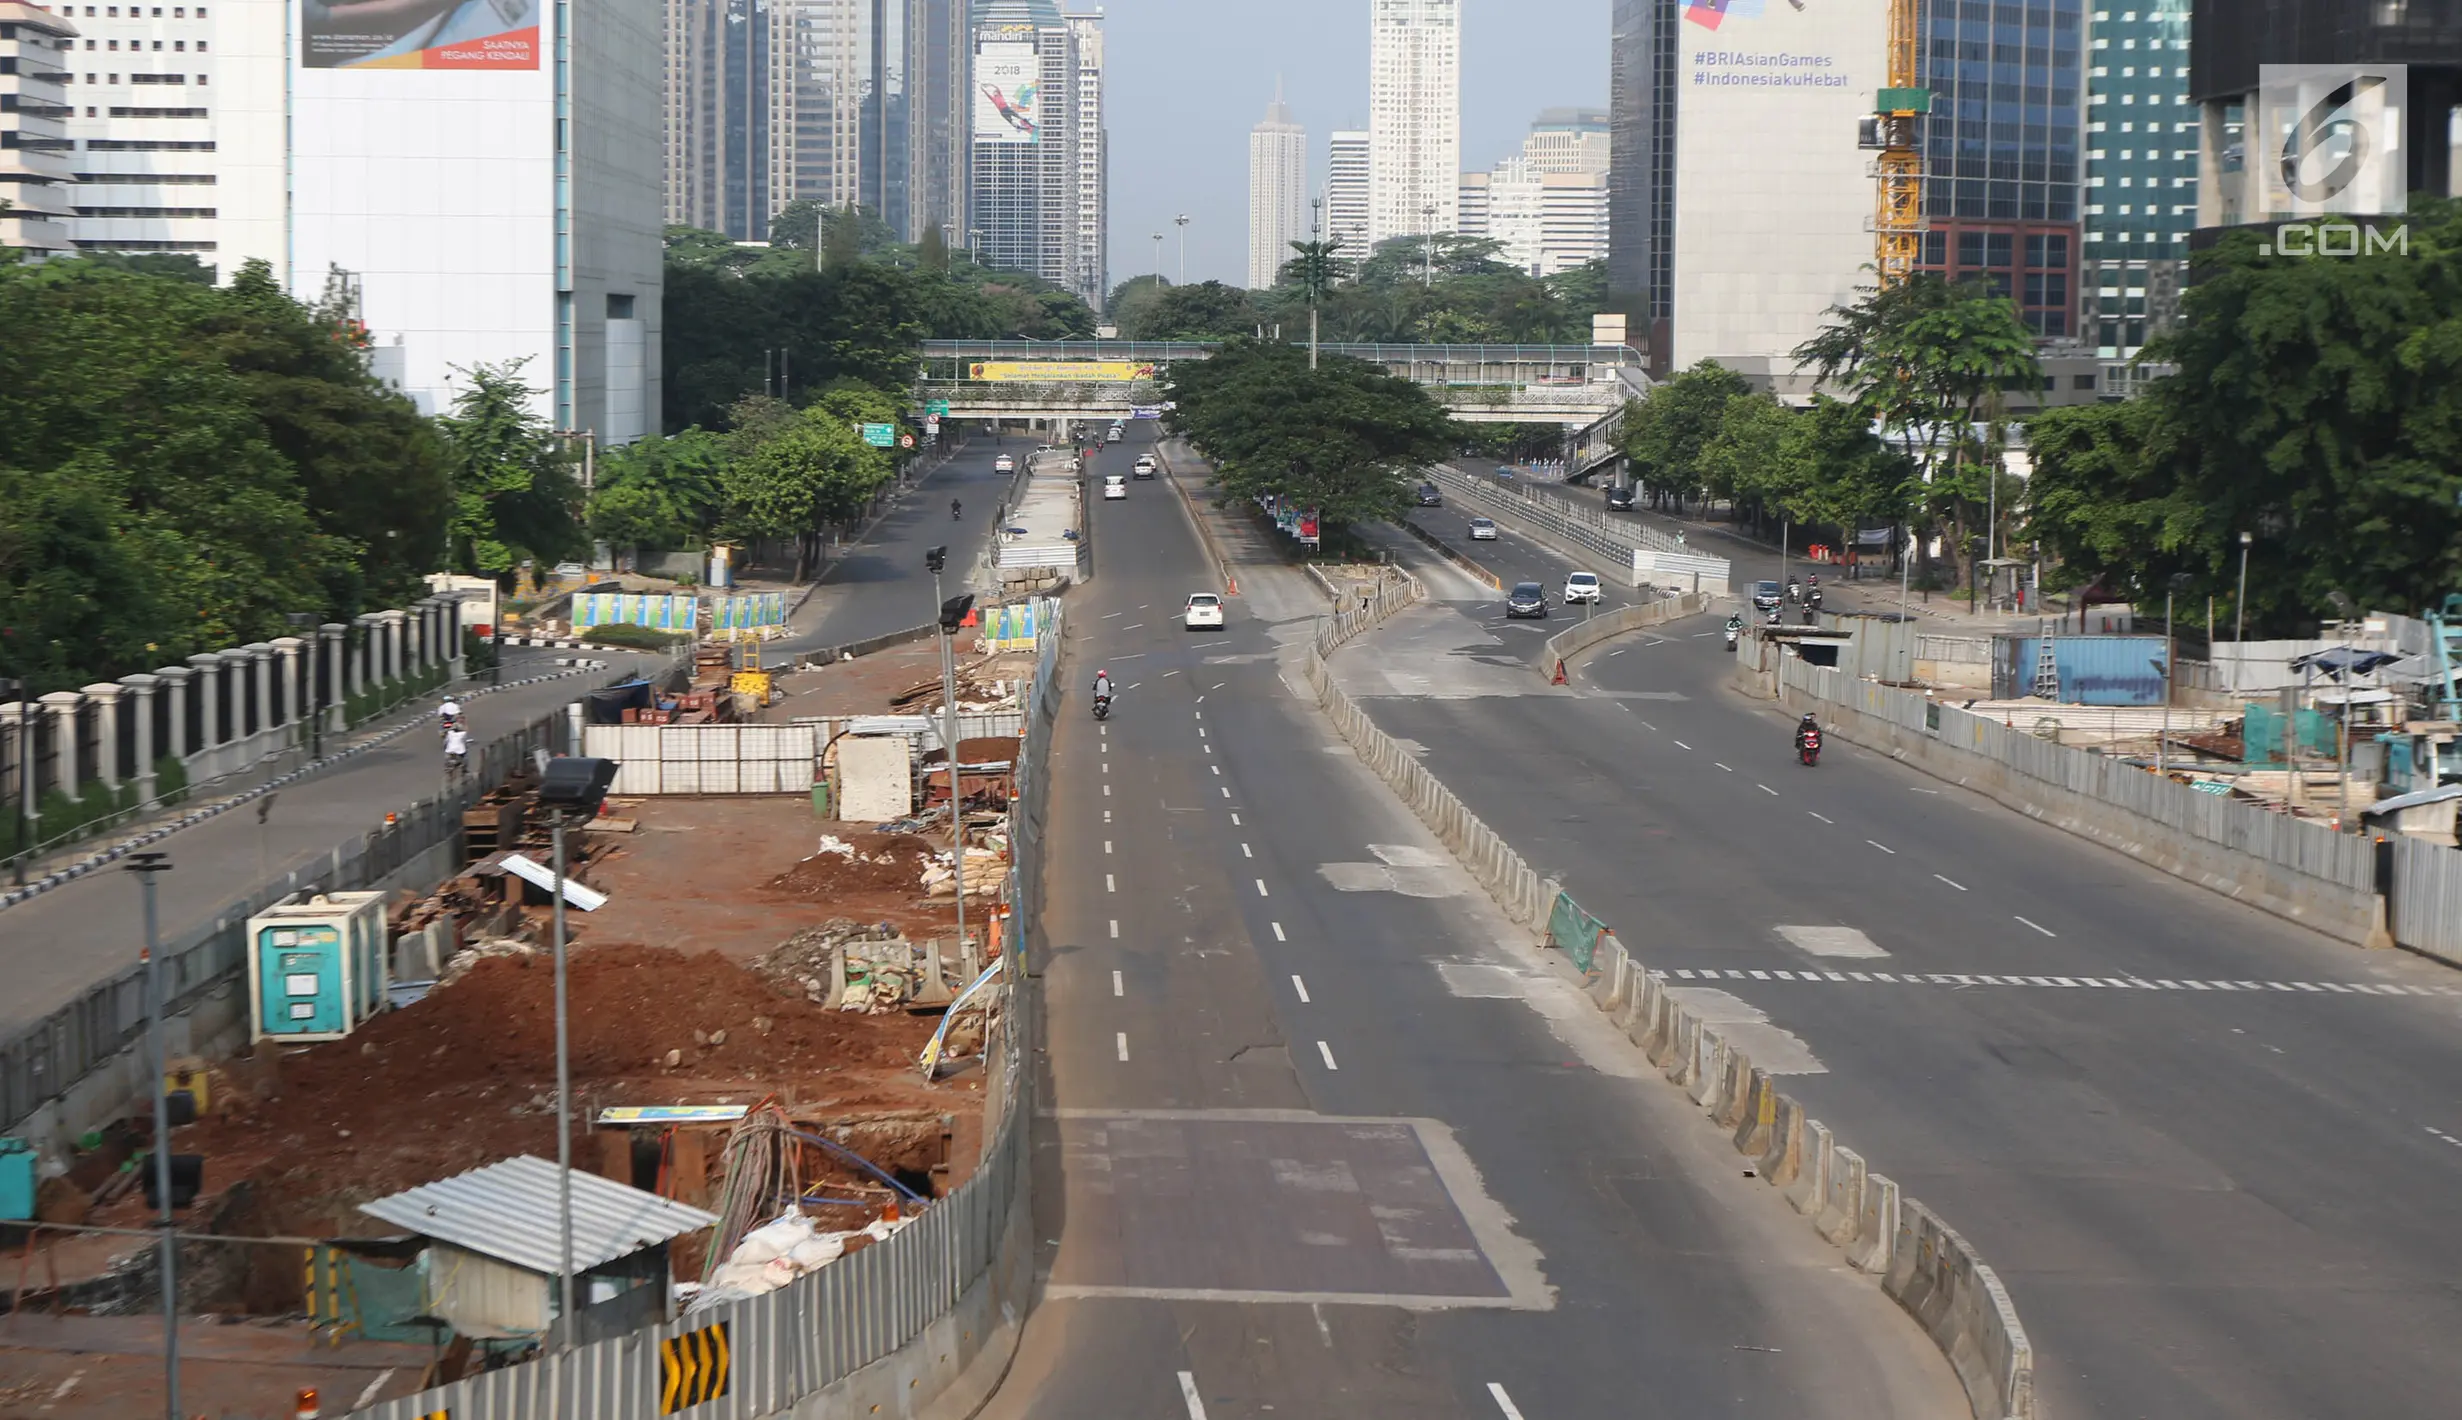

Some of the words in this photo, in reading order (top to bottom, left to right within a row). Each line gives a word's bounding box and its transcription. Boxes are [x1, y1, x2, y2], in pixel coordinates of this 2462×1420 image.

[440, 51, 485, 60] PEGANG
[486, 51, 530, 61] KENDALI
[1694, 51, 1833, 67] #BRIAsianGames
[994, 65, 1021, 75] 2018
[1694, 72, 1848, 87] #IndonesiakuHebat
